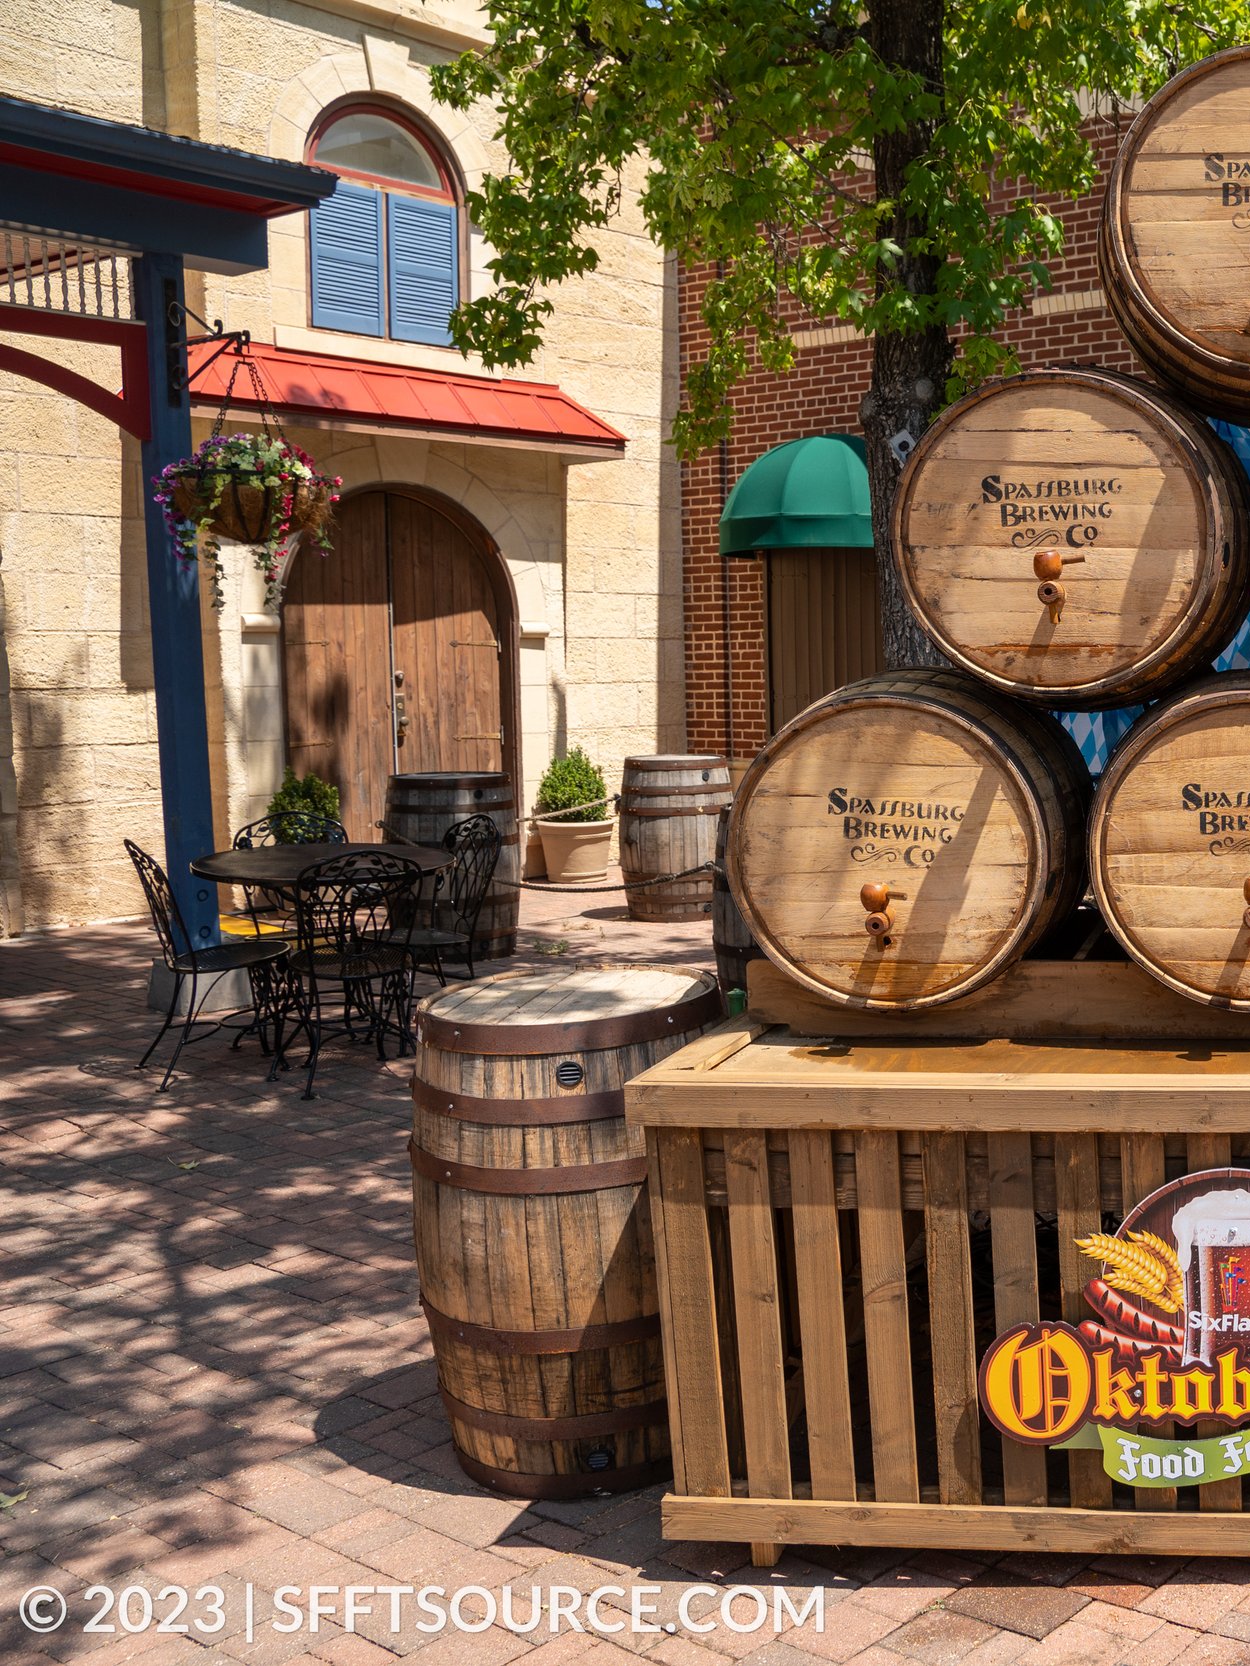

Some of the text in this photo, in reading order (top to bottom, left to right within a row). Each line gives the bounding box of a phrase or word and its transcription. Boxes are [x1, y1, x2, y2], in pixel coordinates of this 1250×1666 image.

[1000, 501, 1113, 527] BREWING
[842, 816, 953, 844] BREWING
[1117, 1436, 1205, 1482] Food
